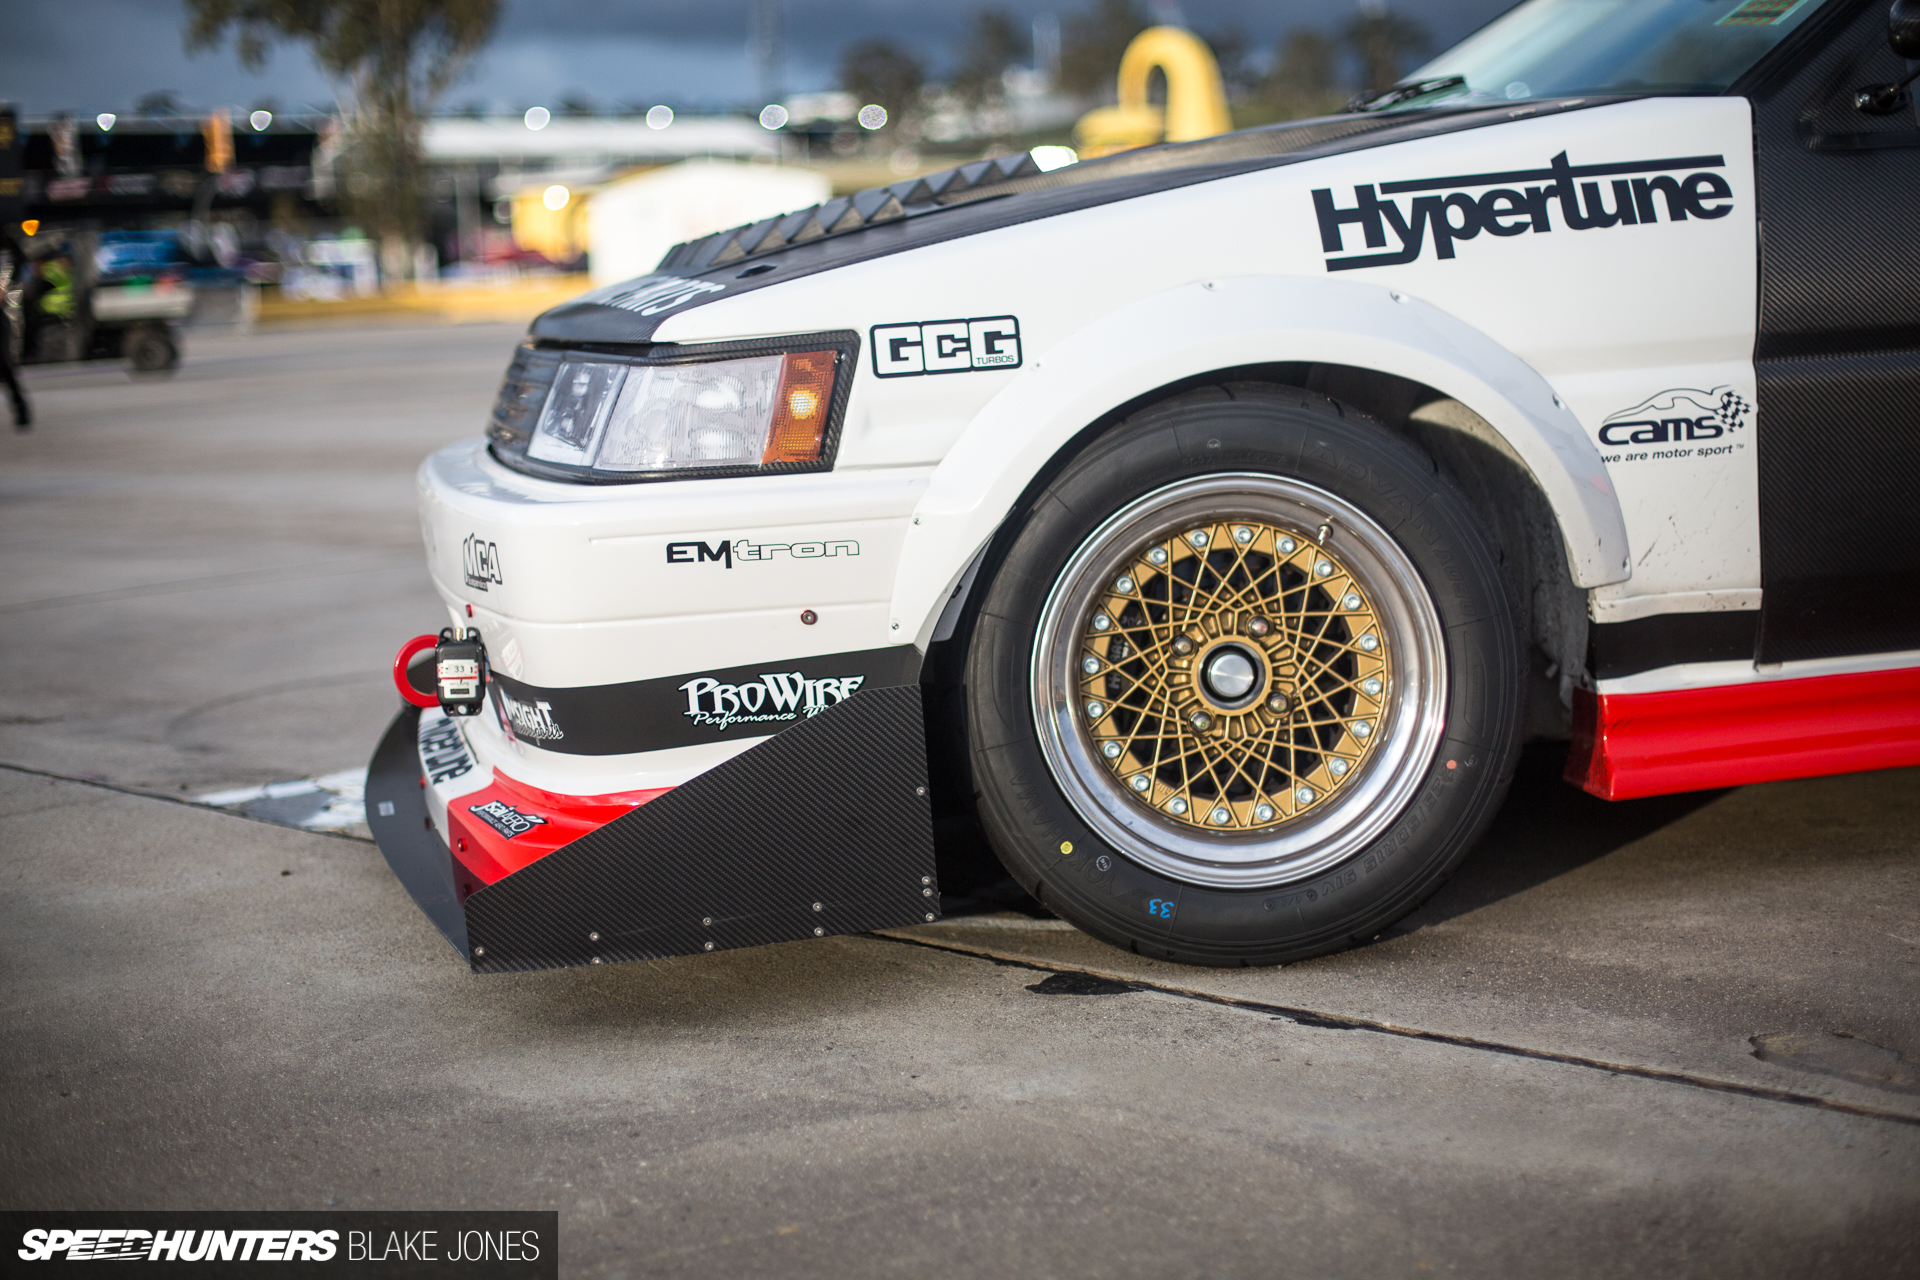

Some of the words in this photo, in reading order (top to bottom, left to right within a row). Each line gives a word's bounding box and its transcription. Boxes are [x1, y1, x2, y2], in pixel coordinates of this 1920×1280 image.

[1311, 150, 1734, 272] Hypertune
[869, 314, 1023, 379] GCG
[976, 354, 1015, 365] TURBOS
[1598, 415, 1724, 446] cams
[1601, 454, 1621, 464] we
[1625, 453, 1648, 462] are
[1652, 448, 1693, 460] motor
[1697, 444, 1733, 458] sport
[463, 532, 503, 585] MCA
[454, 665, 465, 673] 33
[690, 710, 797, 731] Performance
